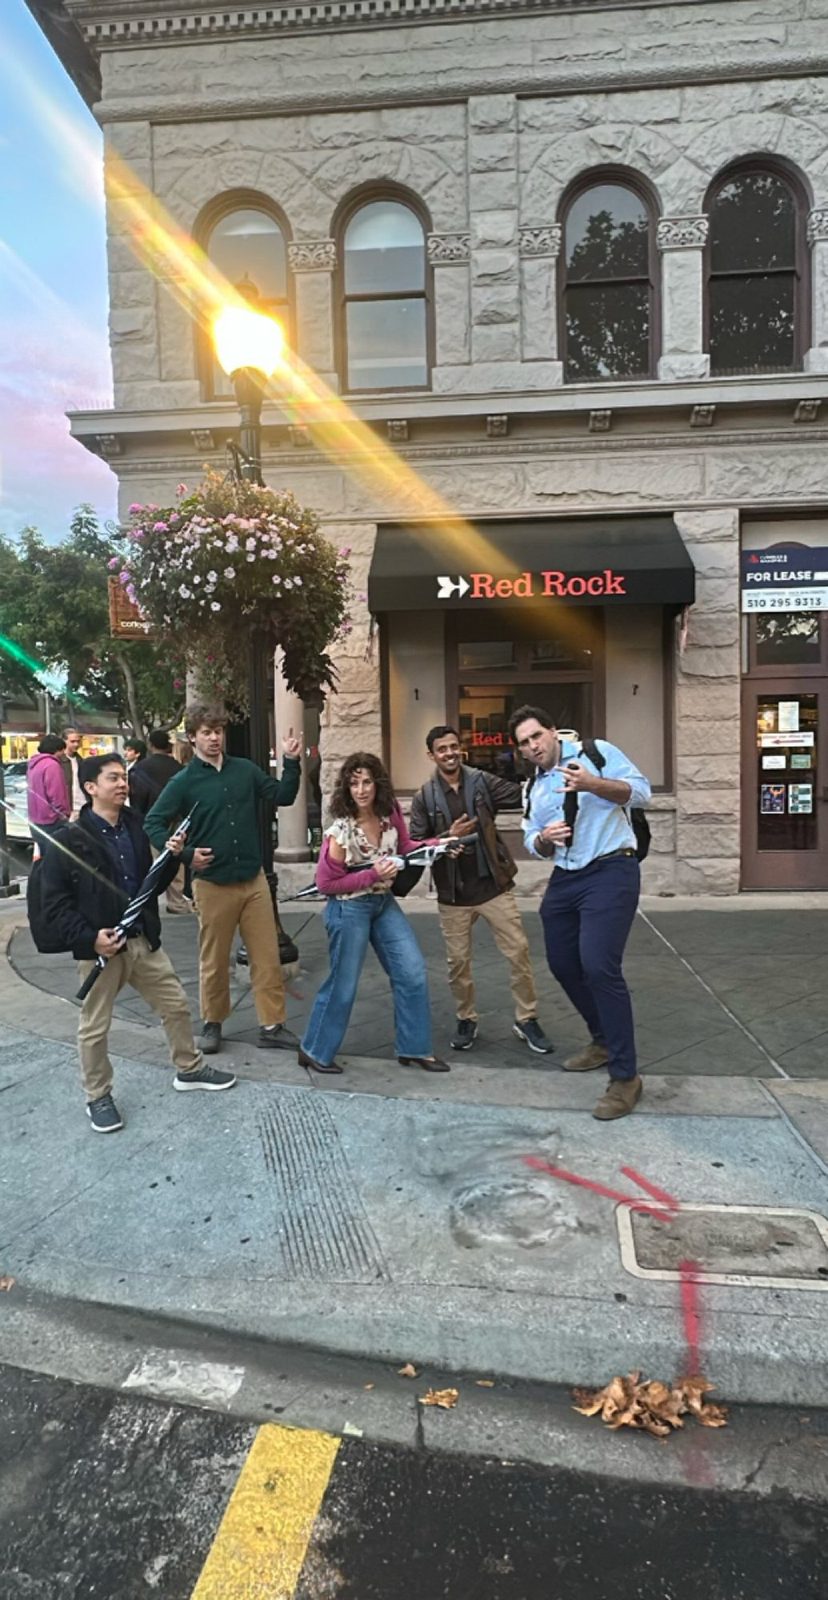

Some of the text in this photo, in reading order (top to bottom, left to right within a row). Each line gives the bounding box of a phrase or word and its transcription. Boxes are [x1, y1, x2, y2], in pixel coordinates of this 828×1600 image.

[746, 571, 812, 582] FOR LEASE
[470, 570, 626, 598] Red Rock
[747, 597, 822, 608] 510 295 9313
[471, 732, 504, 746] Red
